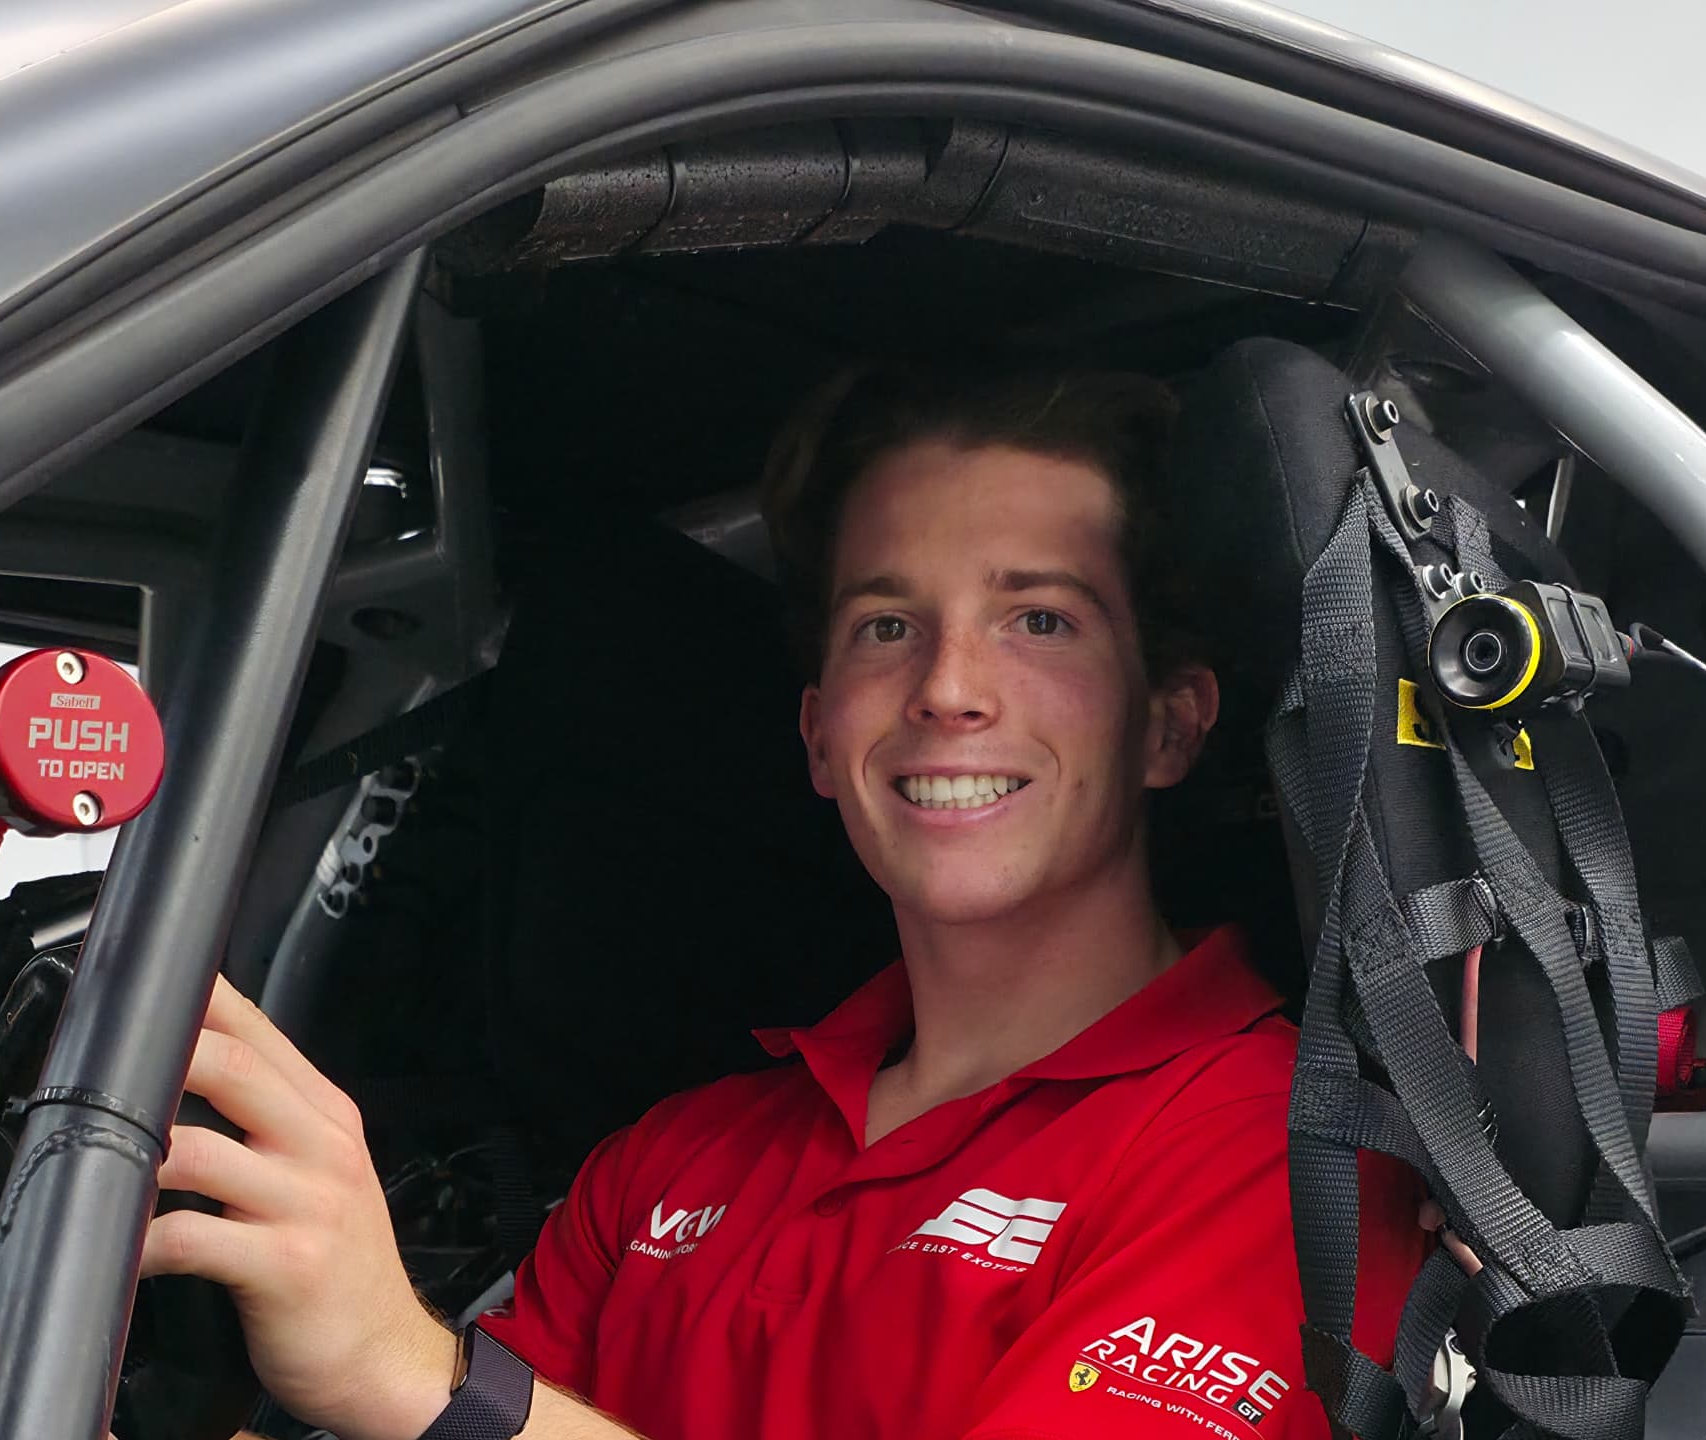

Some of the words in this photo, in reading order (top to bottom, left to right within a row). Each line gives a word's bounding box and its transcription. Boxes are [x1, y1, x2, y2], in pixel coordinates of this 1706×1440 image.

[28, 717, 129, 753] PUSH
[38, 759, 64, 778] TO
[68, 760, 124, 781] OPEN
[922, 1242, 959, 1255] EAST
[961, 1252, 1028, 1273] EXOTICS
[1082, 1338, 1234, 1404] RACING
[1236, 1400, 1263, 1422] GT
[1109, 1316, 1290, 1410] ARISE
[1106, 1386, 1162, 1409] RACING
[1166, 1402, 1205, 1425] WITH
